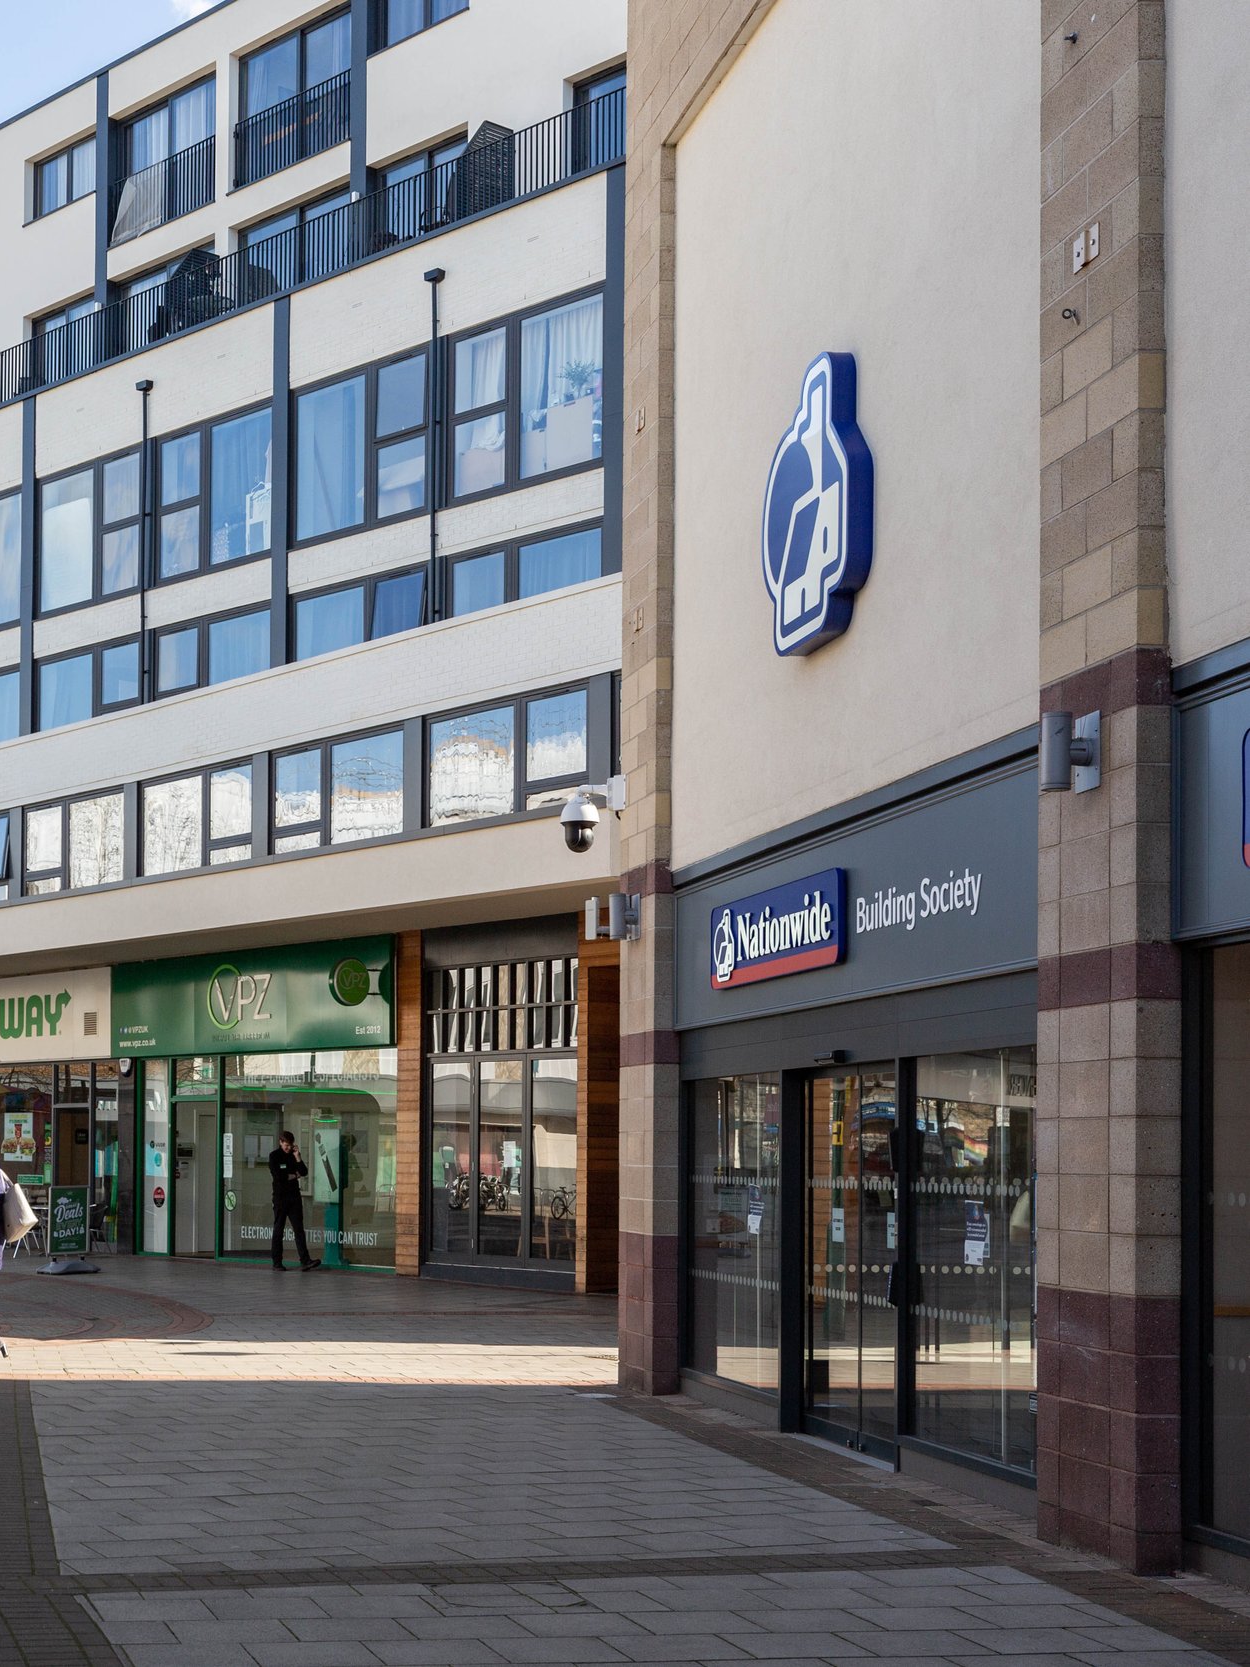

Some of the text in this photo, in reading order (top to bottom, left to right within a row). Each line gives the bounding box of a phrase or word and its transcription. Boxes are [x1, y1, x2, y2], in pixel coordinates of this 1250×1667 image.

[856, 868, 982, 934] Building Society
[736, 890, 831, 962] Nationwide
[342, 971, 367, 989] VPZ
[213, 973, 273, 1022] VPZ
[355, 1026, 382, 1035] Est 2012
[119, 1038, 156, 1049] www.vpz.co.uk
[54, 1203, 84, 1223] Deals
[59, 1226, 80, 1239] DAY!
[241, 1225, 274, 1240] ELECTRON
[324, 1230, 337, 1244] YOU
[338, 1231, 353, 1245] CAN
[355, 1231, 379, 1246] TRUST
